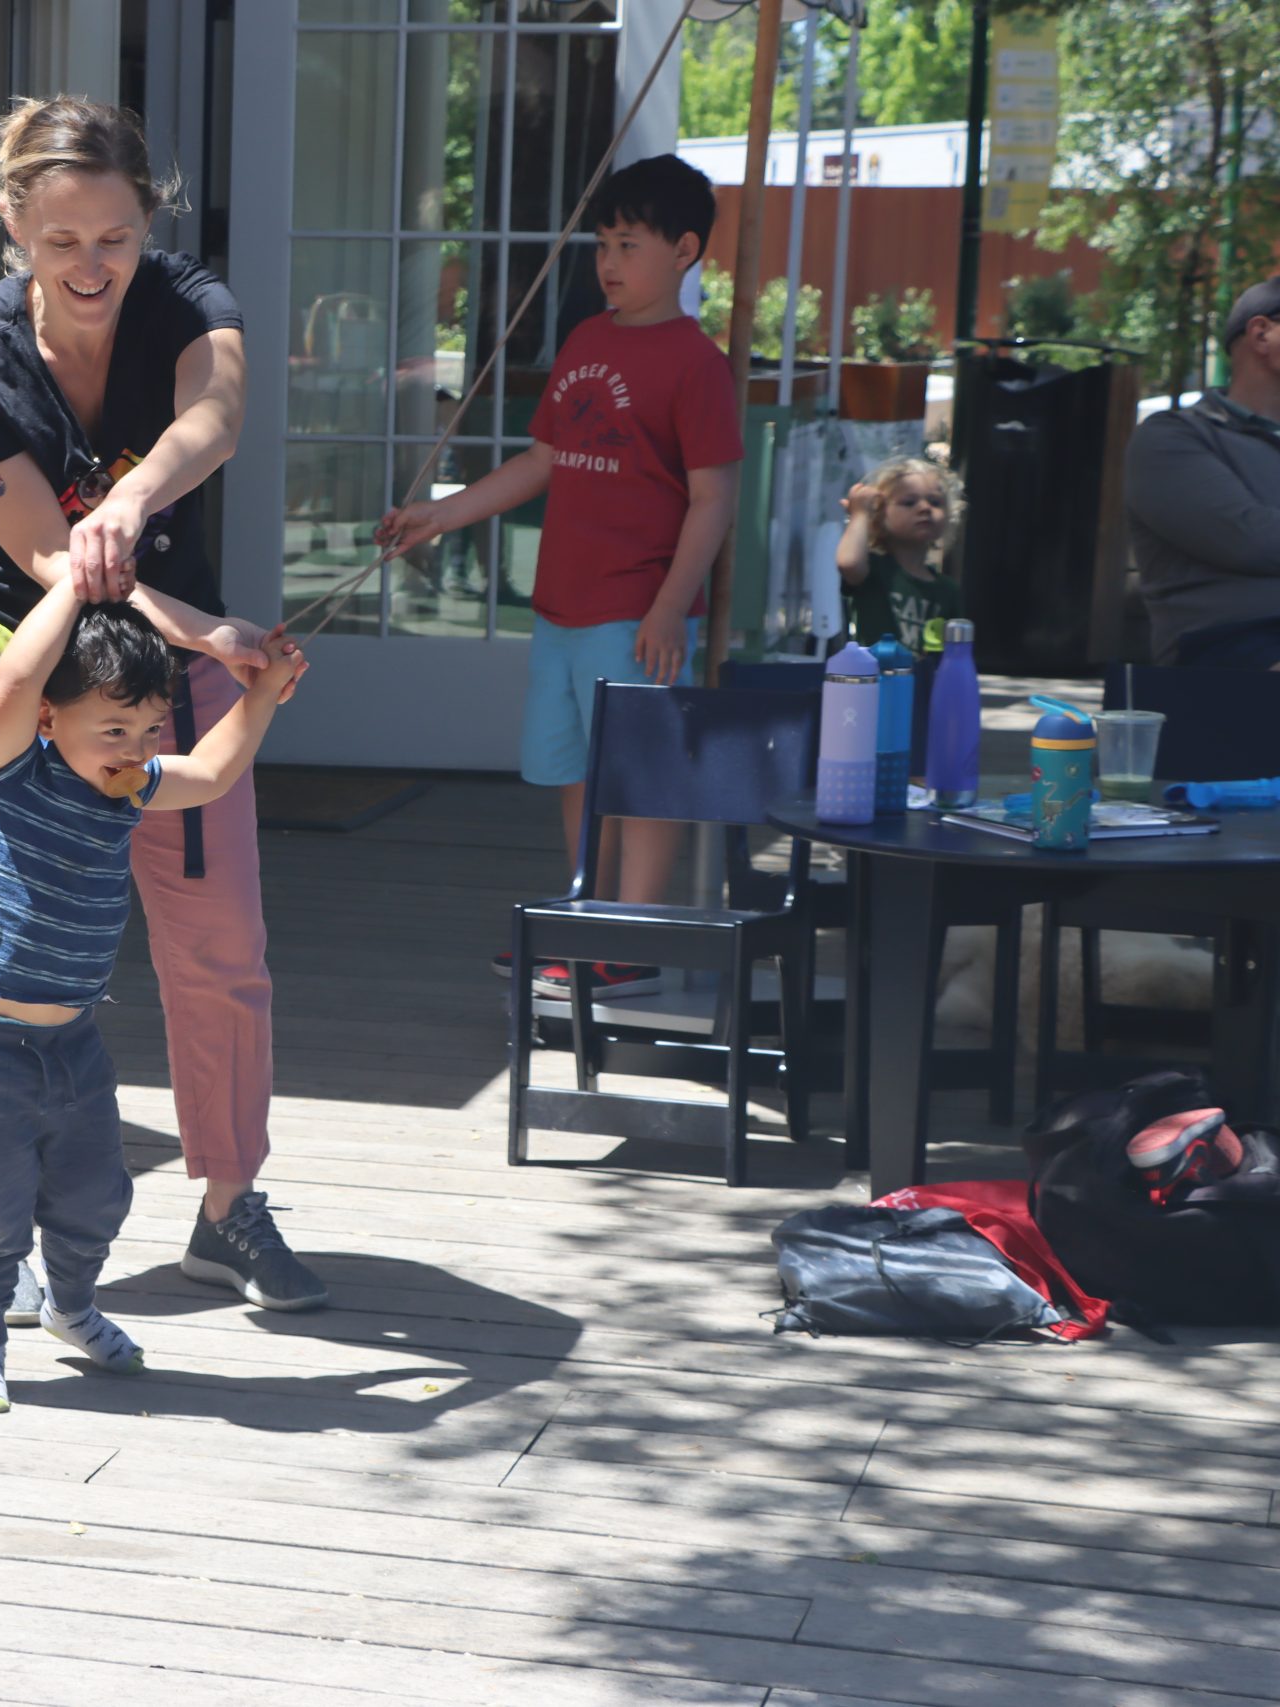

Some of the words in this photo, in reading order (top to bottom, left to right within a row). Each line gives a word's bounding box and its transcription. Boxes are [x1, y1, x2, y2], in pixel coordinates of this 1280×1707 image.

[553, 363, 608, 403] BURGER
[607, 372, 631, 409] RUN
[553, 449, 619, 473] HAMPION
